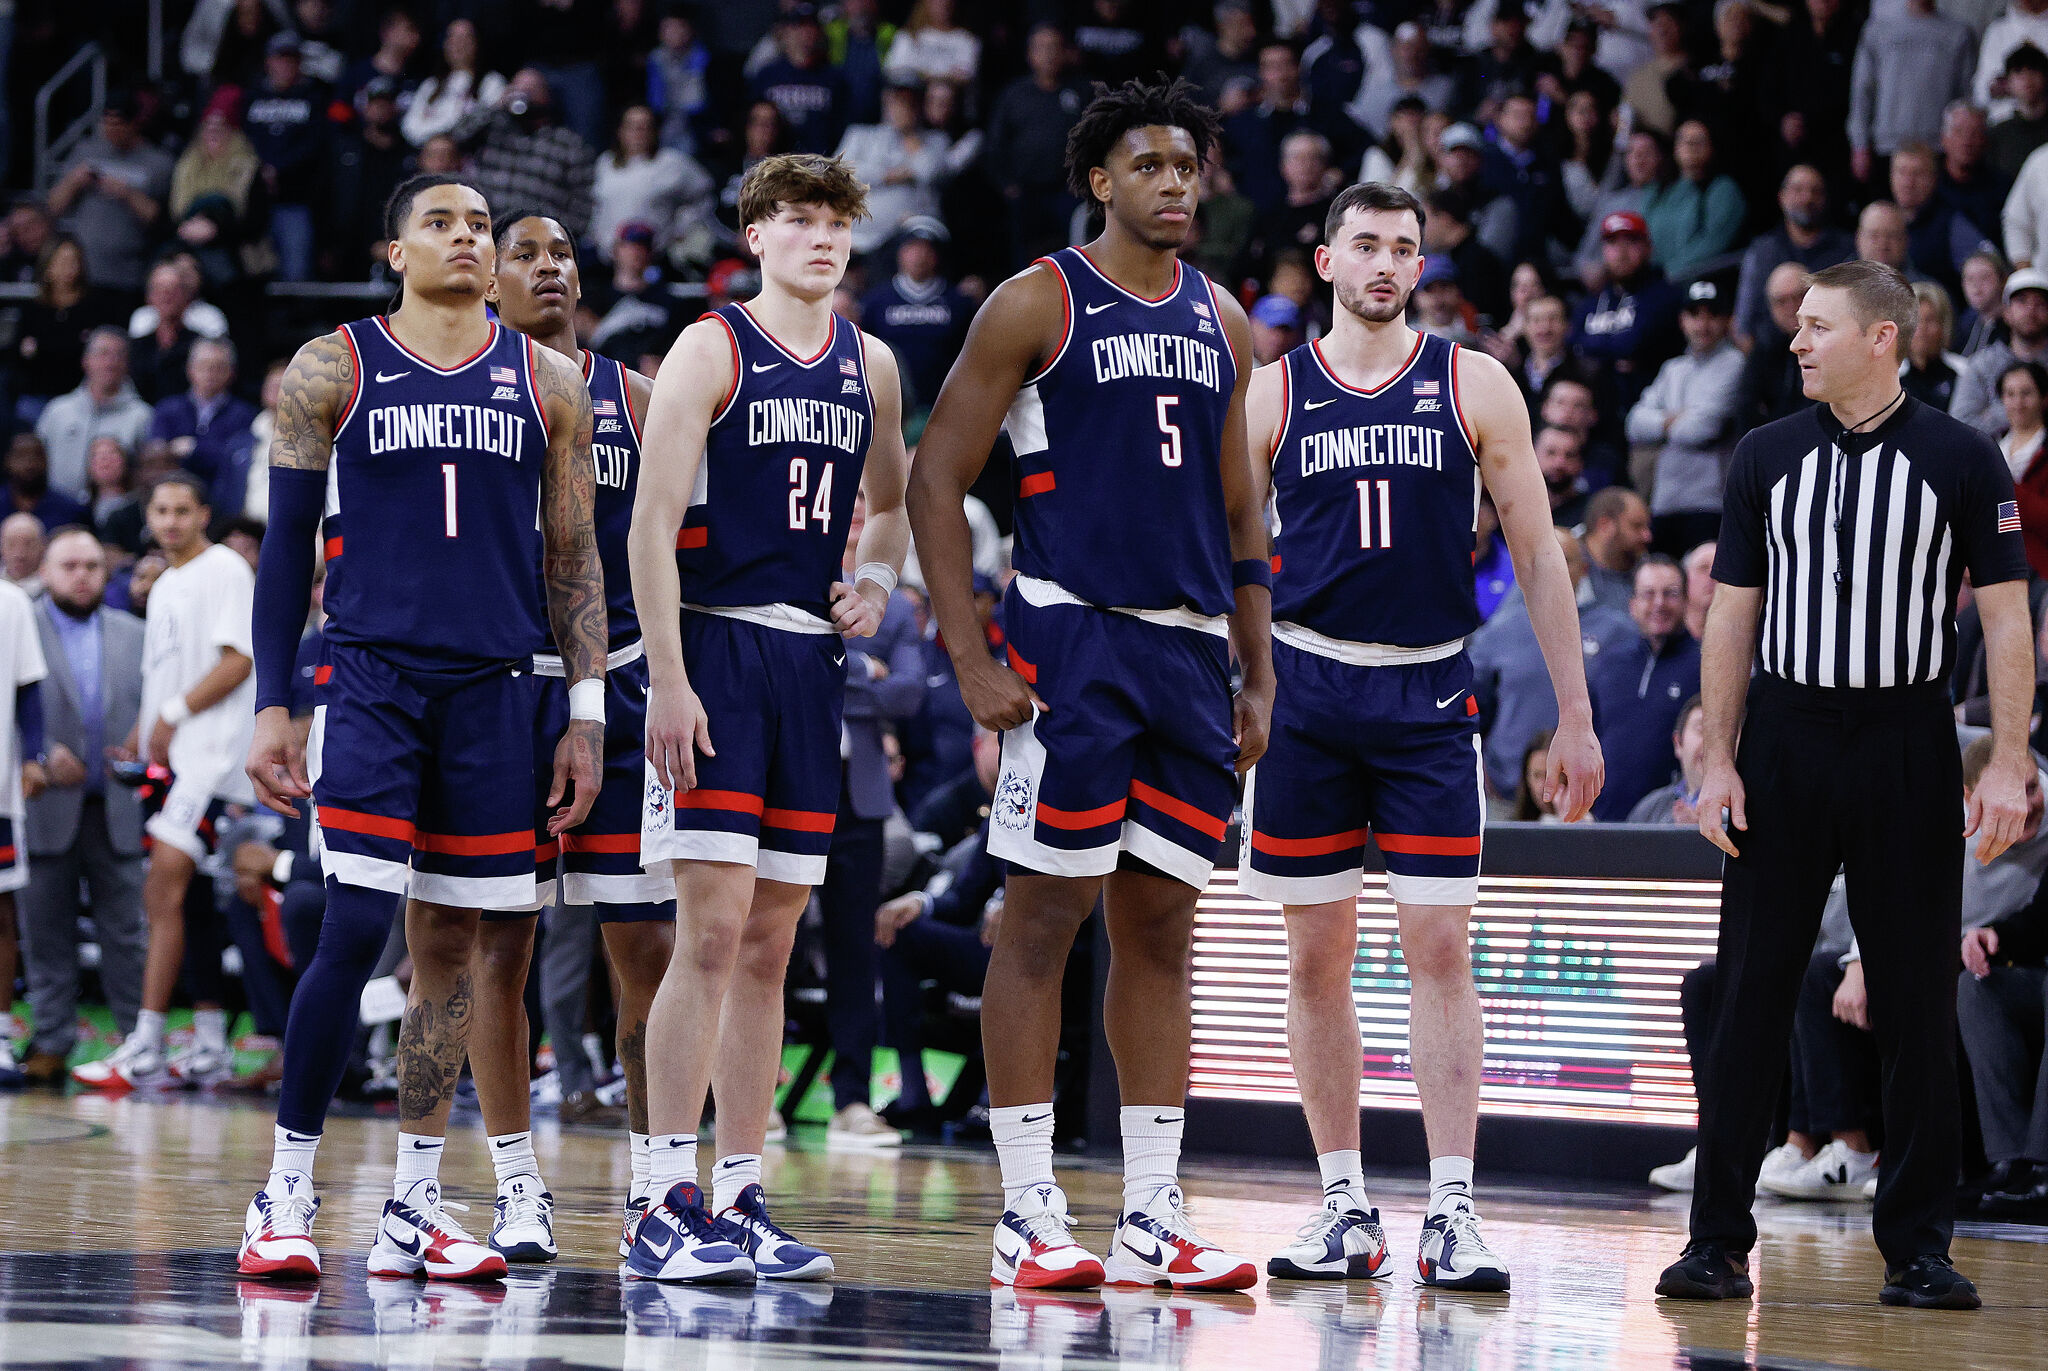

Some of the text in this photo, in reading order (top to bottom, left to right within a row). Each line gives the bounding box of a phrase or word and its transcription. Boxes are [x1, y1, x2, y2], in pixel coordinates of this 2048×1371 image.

[1092, 333, 1220, 393] CONNECTICUT
[368, 404, 526, 462] CONNECTICUT
[748, 398, 865, 455] CONNECTICUT
[1156, 395, 1182, 467] 5
[1301, 424, 1444, 478] CONNECTICUT
[441, 463, 458, 538] 1
[789, 457, 835, 534] 24
[1356, 479, 1392, 548] 11
